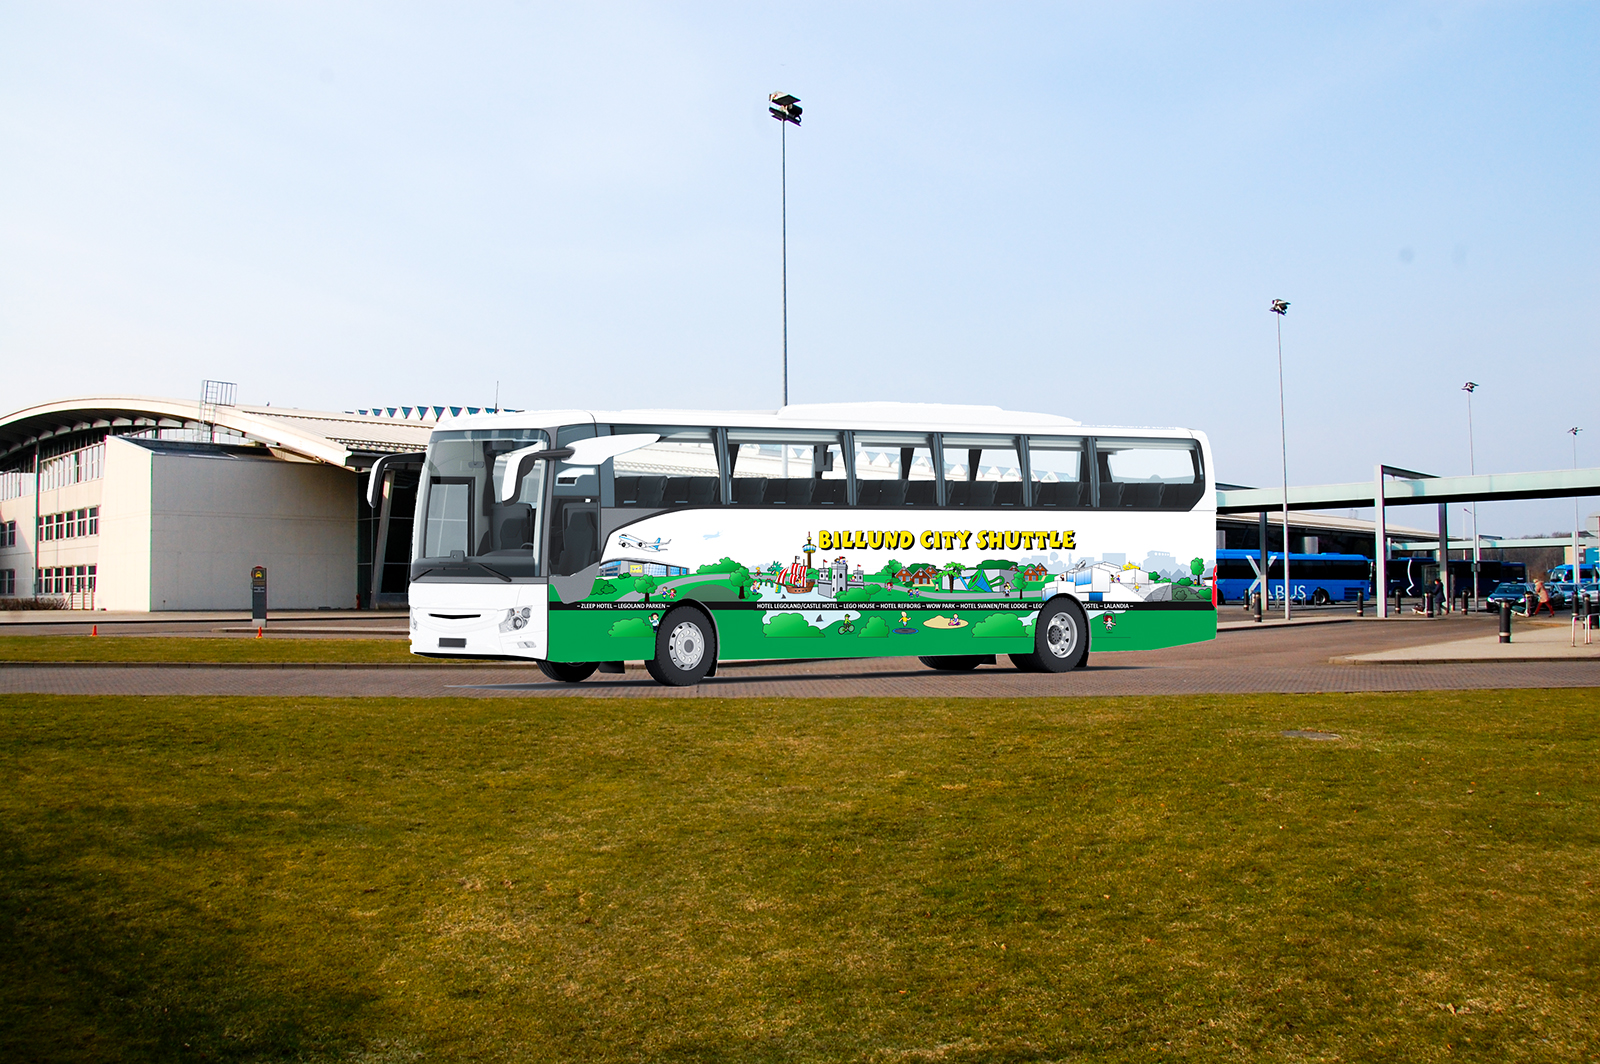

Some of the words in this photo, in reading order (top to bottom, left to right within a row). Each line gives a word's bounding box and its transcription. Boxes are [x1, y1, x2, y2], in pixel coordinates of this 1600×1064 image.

[818, 530, 915, 550] BILLUND
[920, 530, 973, 550] CITY
[976, 530, 1076, 550] SHUTTLE
